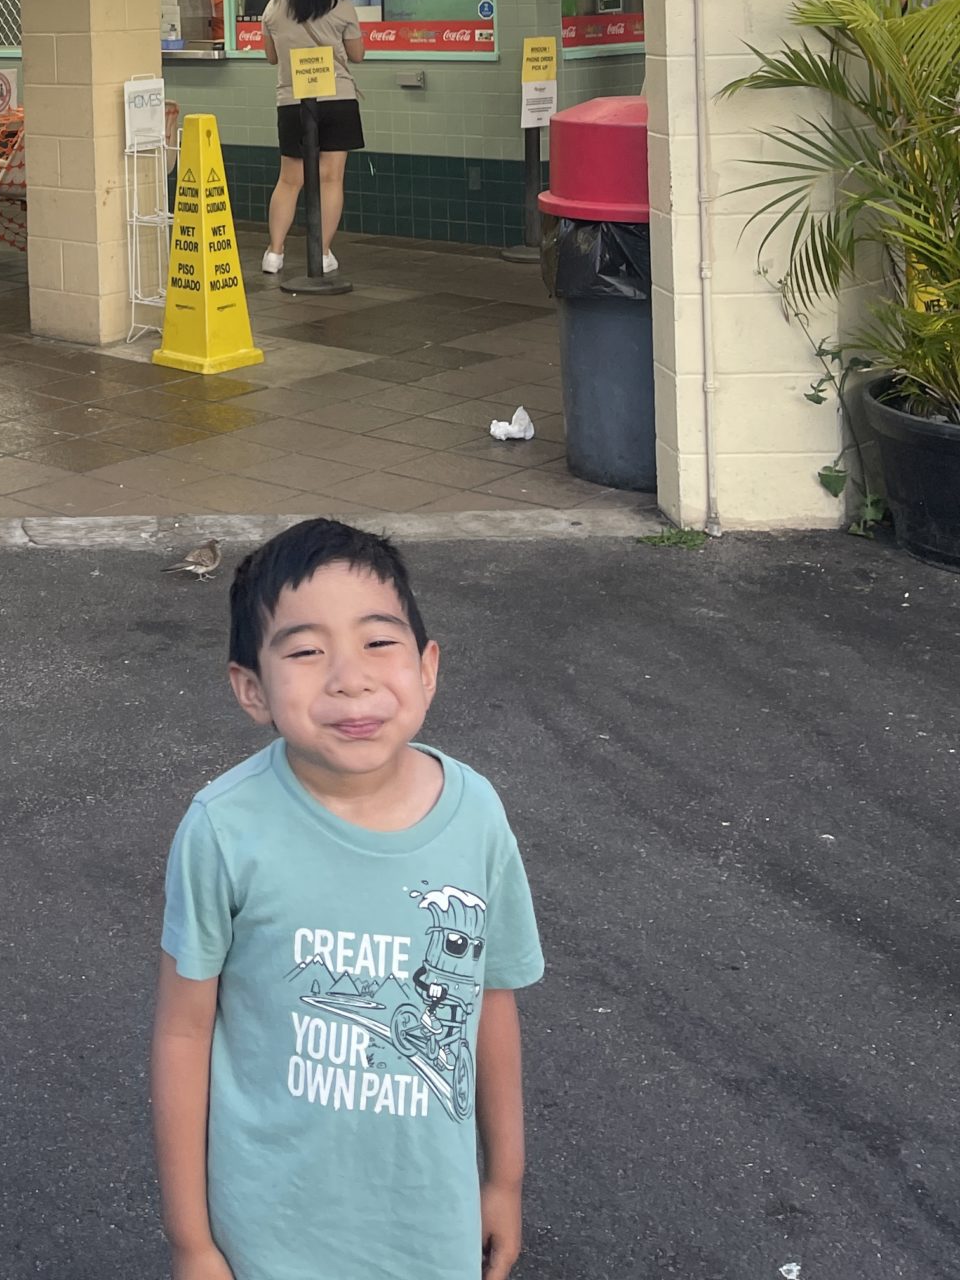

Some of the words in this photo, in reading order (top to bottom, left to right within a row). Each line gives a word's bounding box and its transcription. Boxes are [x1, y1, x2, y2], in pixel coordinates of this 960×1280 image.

[128, 93, 161, 109] HOMES
[178, 186, 199, 198] CAUTION
[205, 186, 225, 198] CAUTION
[178, 202, 199, 214] CUIDADO
[206, 201, 227, 214] CUIDADO
[180, 225, 195, 237] WET
[211, 225, 226, 237] WET
[175, 239, 199, 253] FLOOR
[209, 239, 231, 253] FLOOR
[177, 263, 194, 276] PISO
[214, 263, 230, 276] PISO
[171, 277, 200, 292] MOJADO
[210, 276, 238, 292] MOJADO
[294, 927, 411, 980] CREATE
[291, 1012, 370, 1070] YOUR
[288, 1056, 356, 1111] OWN
[359, 1073, 429, 1118] PATH
